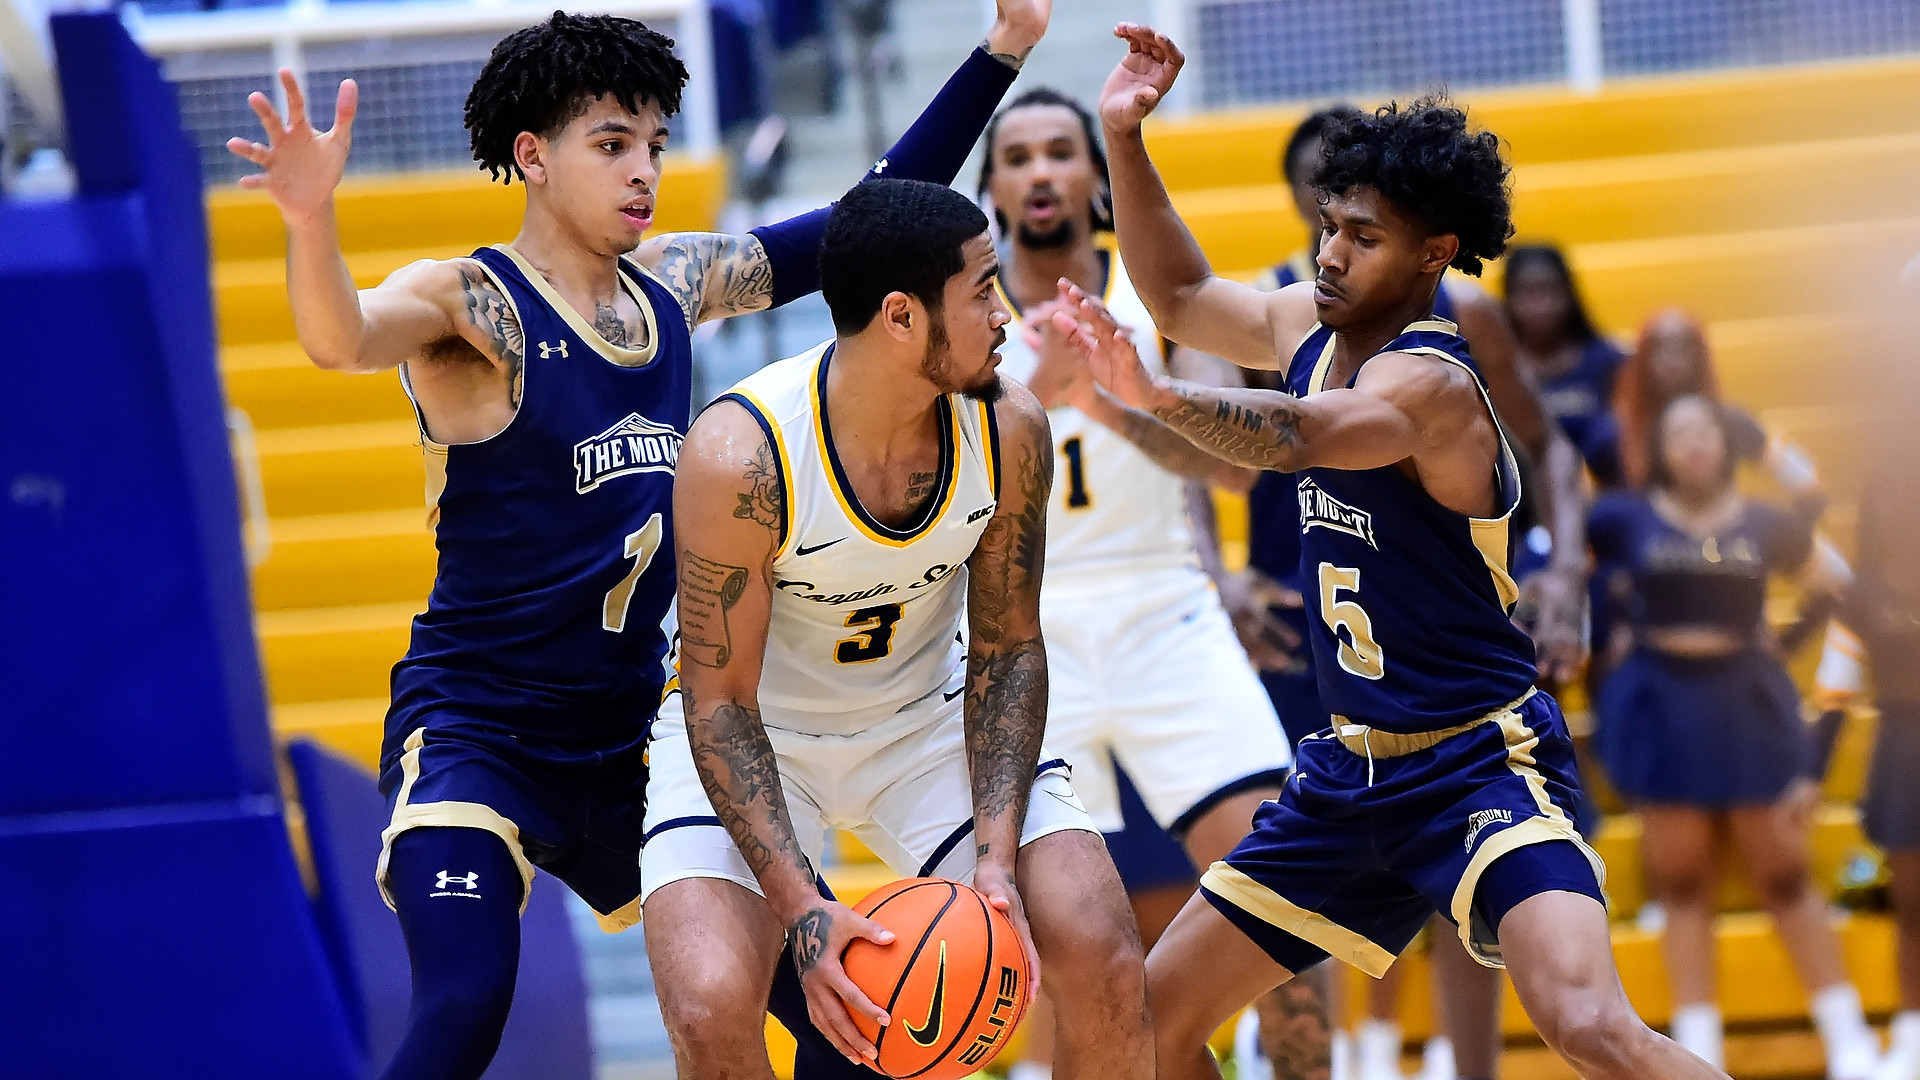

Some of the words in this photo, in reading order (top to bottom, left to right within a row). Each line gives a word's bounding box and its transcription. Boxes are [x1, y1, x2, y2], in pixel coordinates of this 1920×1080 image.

[580, 438, 626, 483] THE
[626, 435, 683, 466] MOUN
[1059, 435, 1096, 512] 1
[602, 512, 663, 633] 1
[832, 602, 906, 665] 3
[1318, 561, 1384, 681] 5
[957, 965, 1019, 1066] ELITE
